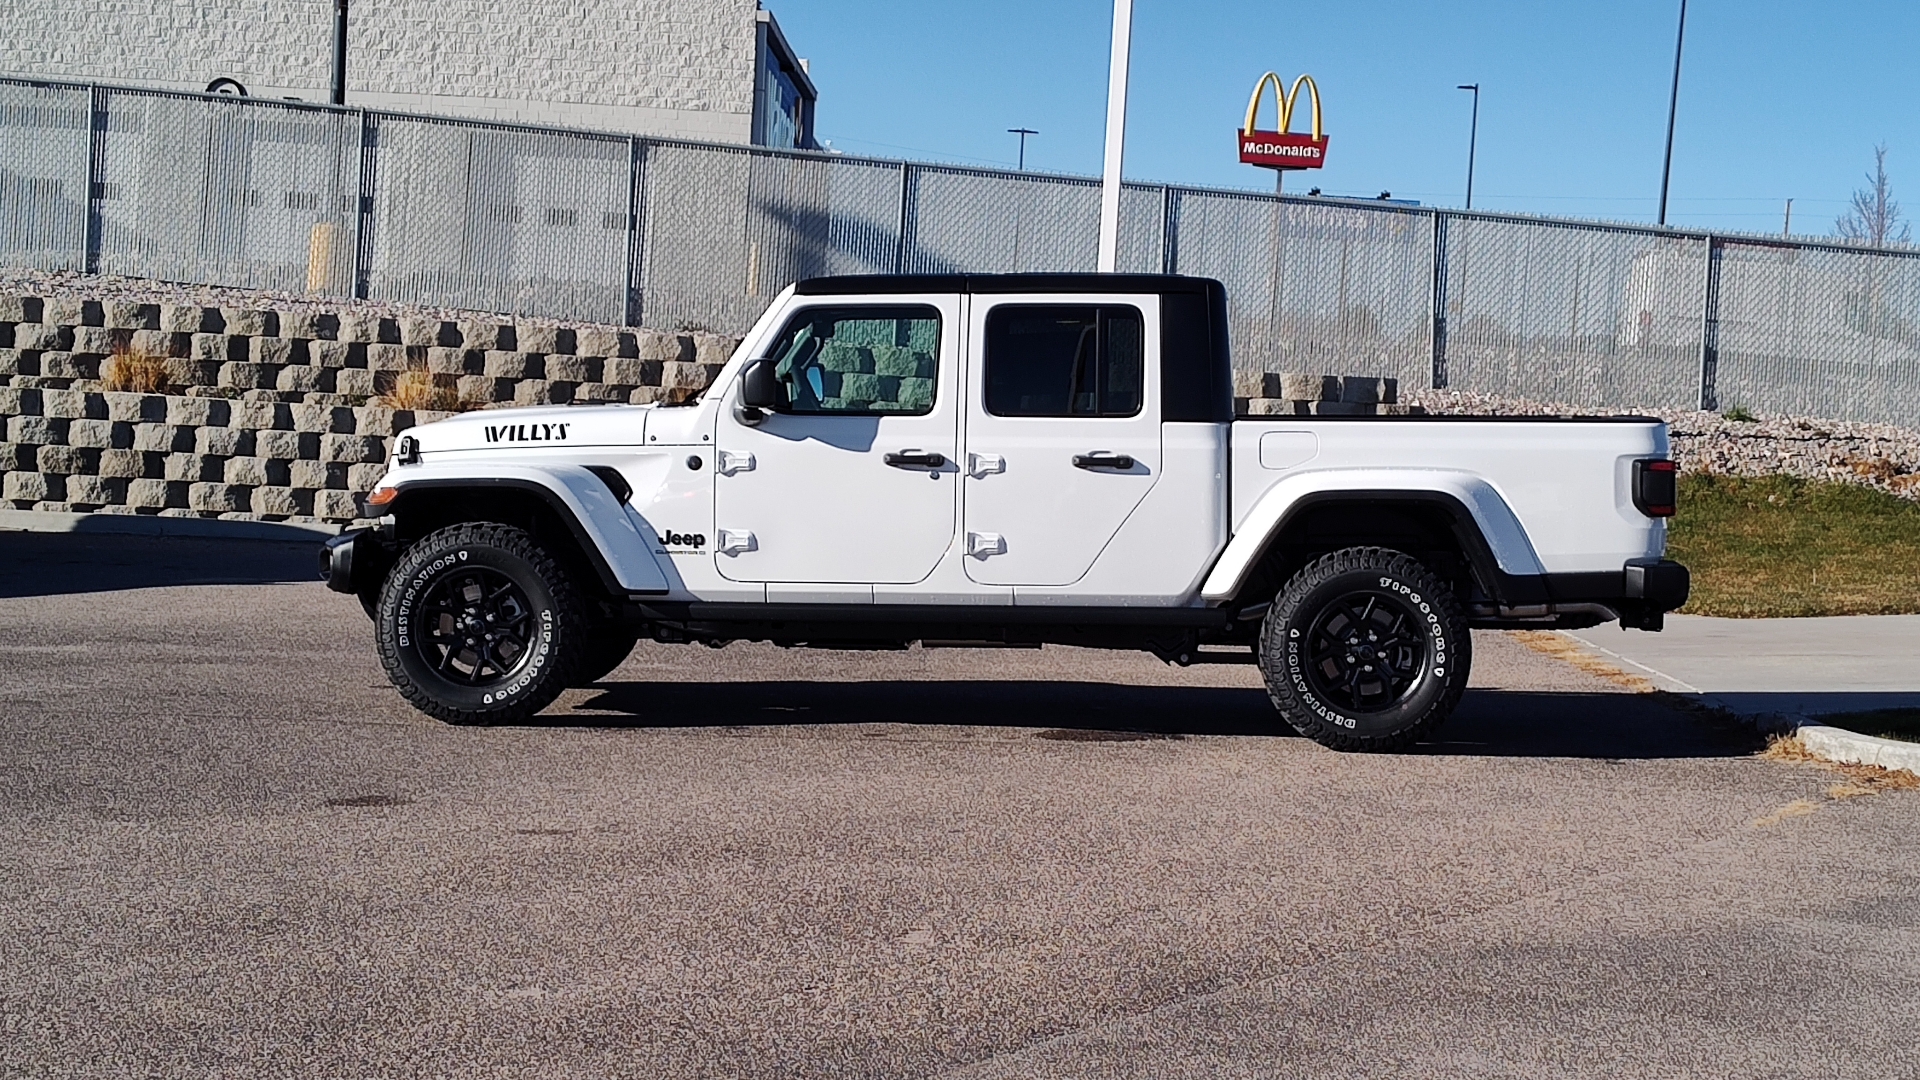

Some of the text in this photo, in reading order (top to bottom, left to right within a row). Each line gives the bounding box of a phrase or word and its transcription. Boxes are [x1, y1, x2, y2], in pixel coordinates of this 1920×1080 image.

[1243, 142, 1321, 158] McDonald's
[485, 423, 570, 443] WILLYS
[658, 529, 706, 549] Jeep
[398, 555, 456, 646] DESTINATION
[1288, 641, 1356, 729] DESTINATION
